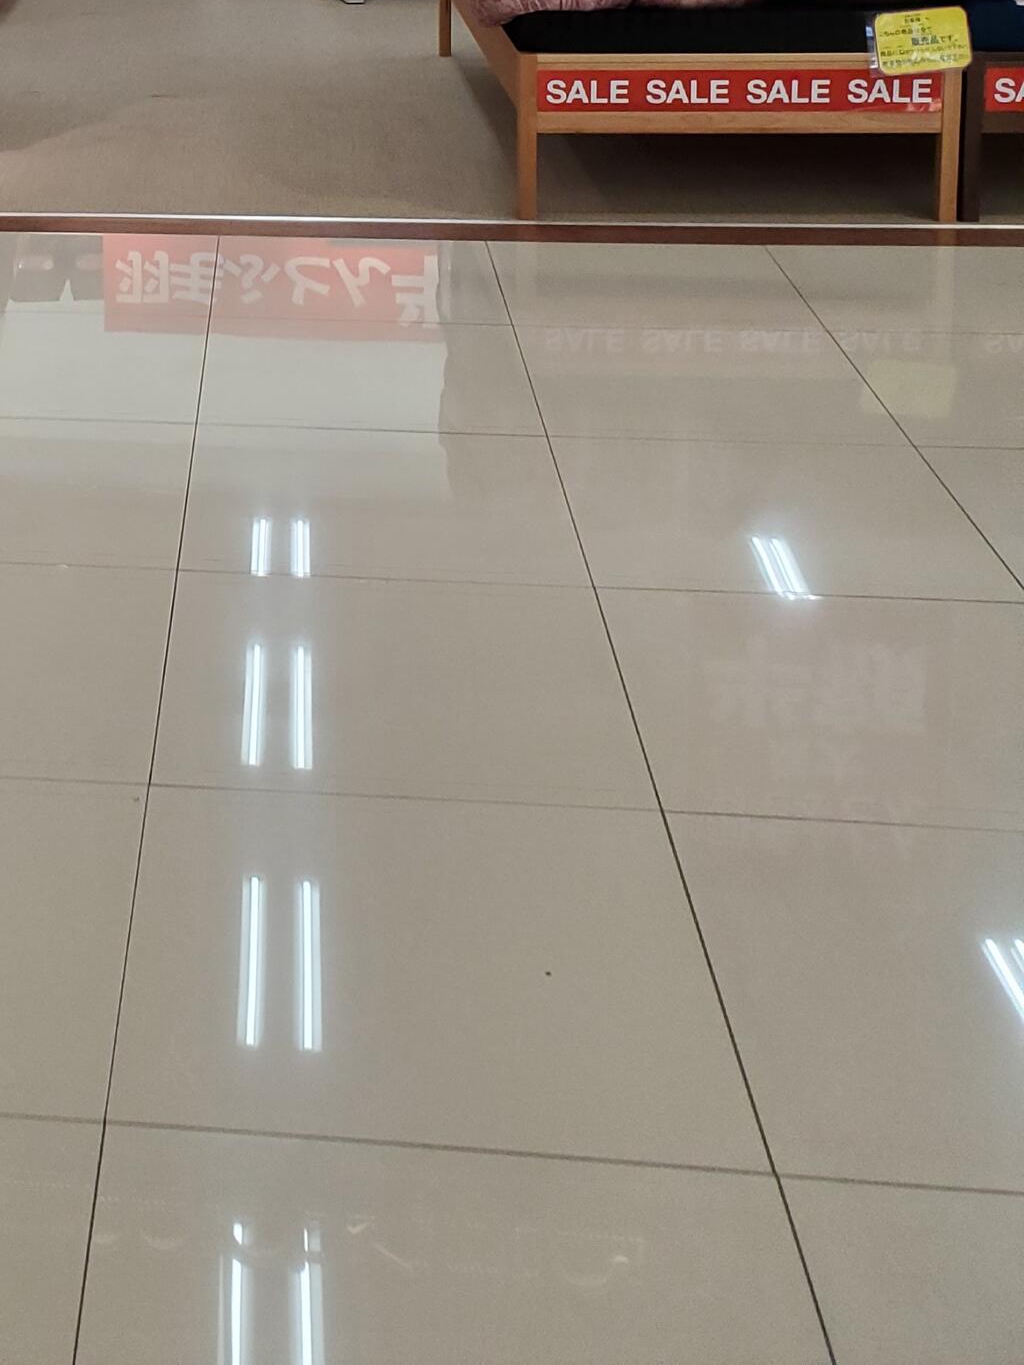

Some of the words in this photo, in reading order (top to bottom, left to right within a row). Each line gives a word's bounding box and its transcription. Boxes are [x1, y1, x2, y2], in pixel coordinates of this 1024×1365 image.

[545, 79, 629, 104] SALE
[646, 79, 730, 104] SALE
[746, 79, 830, 104] SALE
[847, 78, 932, 104] SALE
